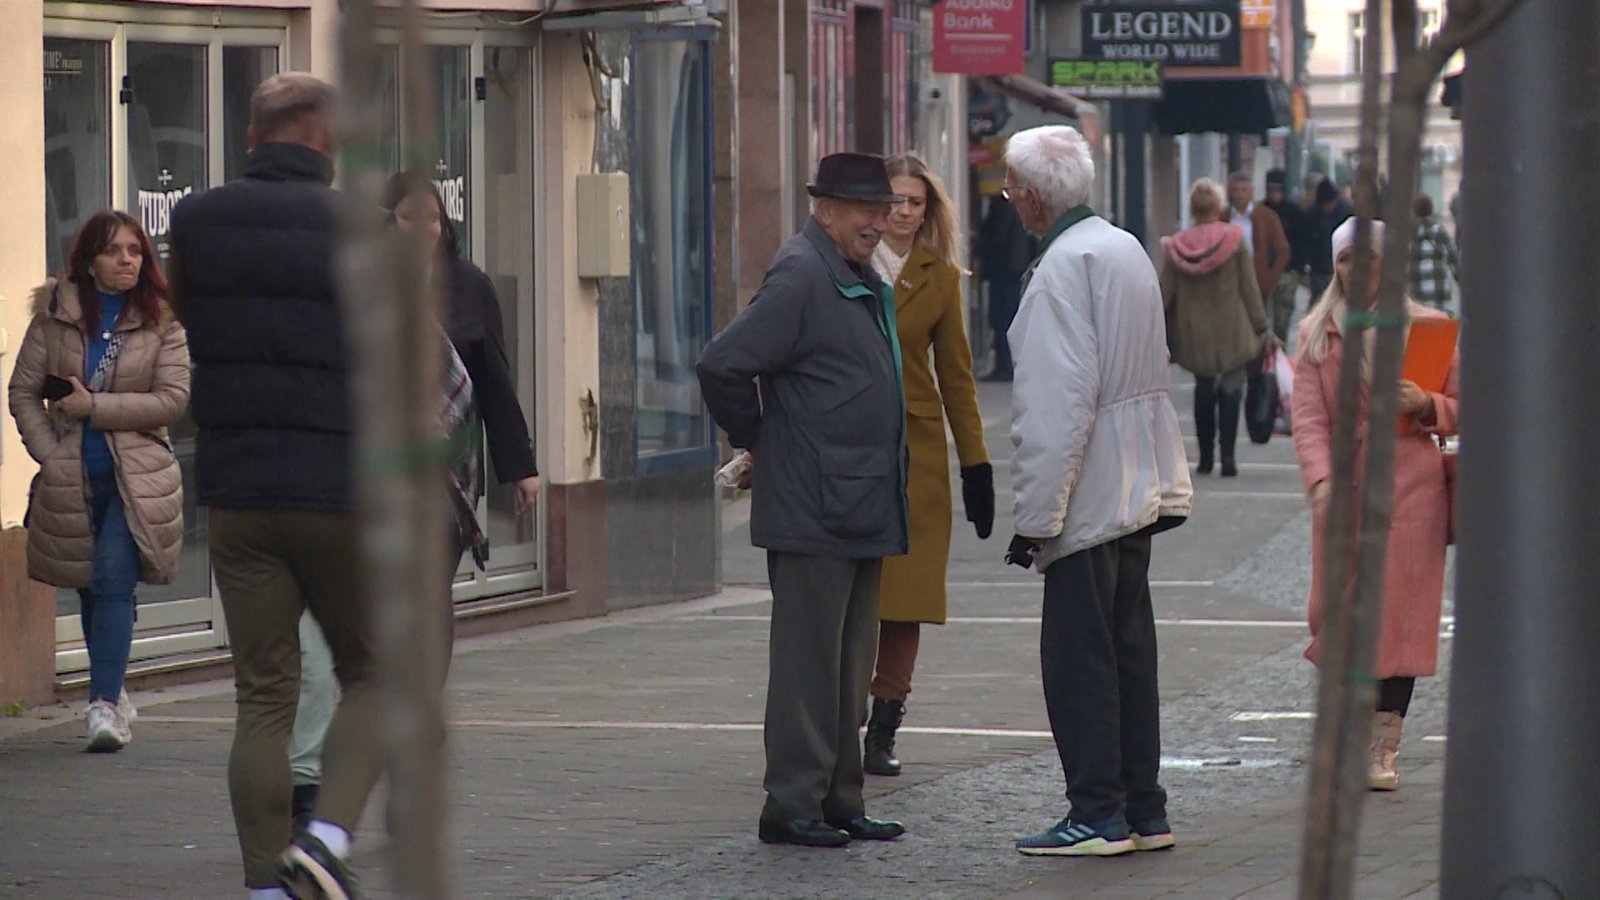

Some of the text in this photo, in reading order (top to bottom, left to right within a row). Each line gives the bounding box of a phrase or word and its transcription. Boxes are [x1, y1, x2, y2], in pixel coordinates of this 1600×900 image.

[944, 12, 993, 29] Bank
[1091, 11, 1232, 39] LEGEND
[1102, 44, 1220, 58] WORLD WIDE
[1053, 61, 1160, 85] SPARK
[138, 186, 192, 237] TUBO
